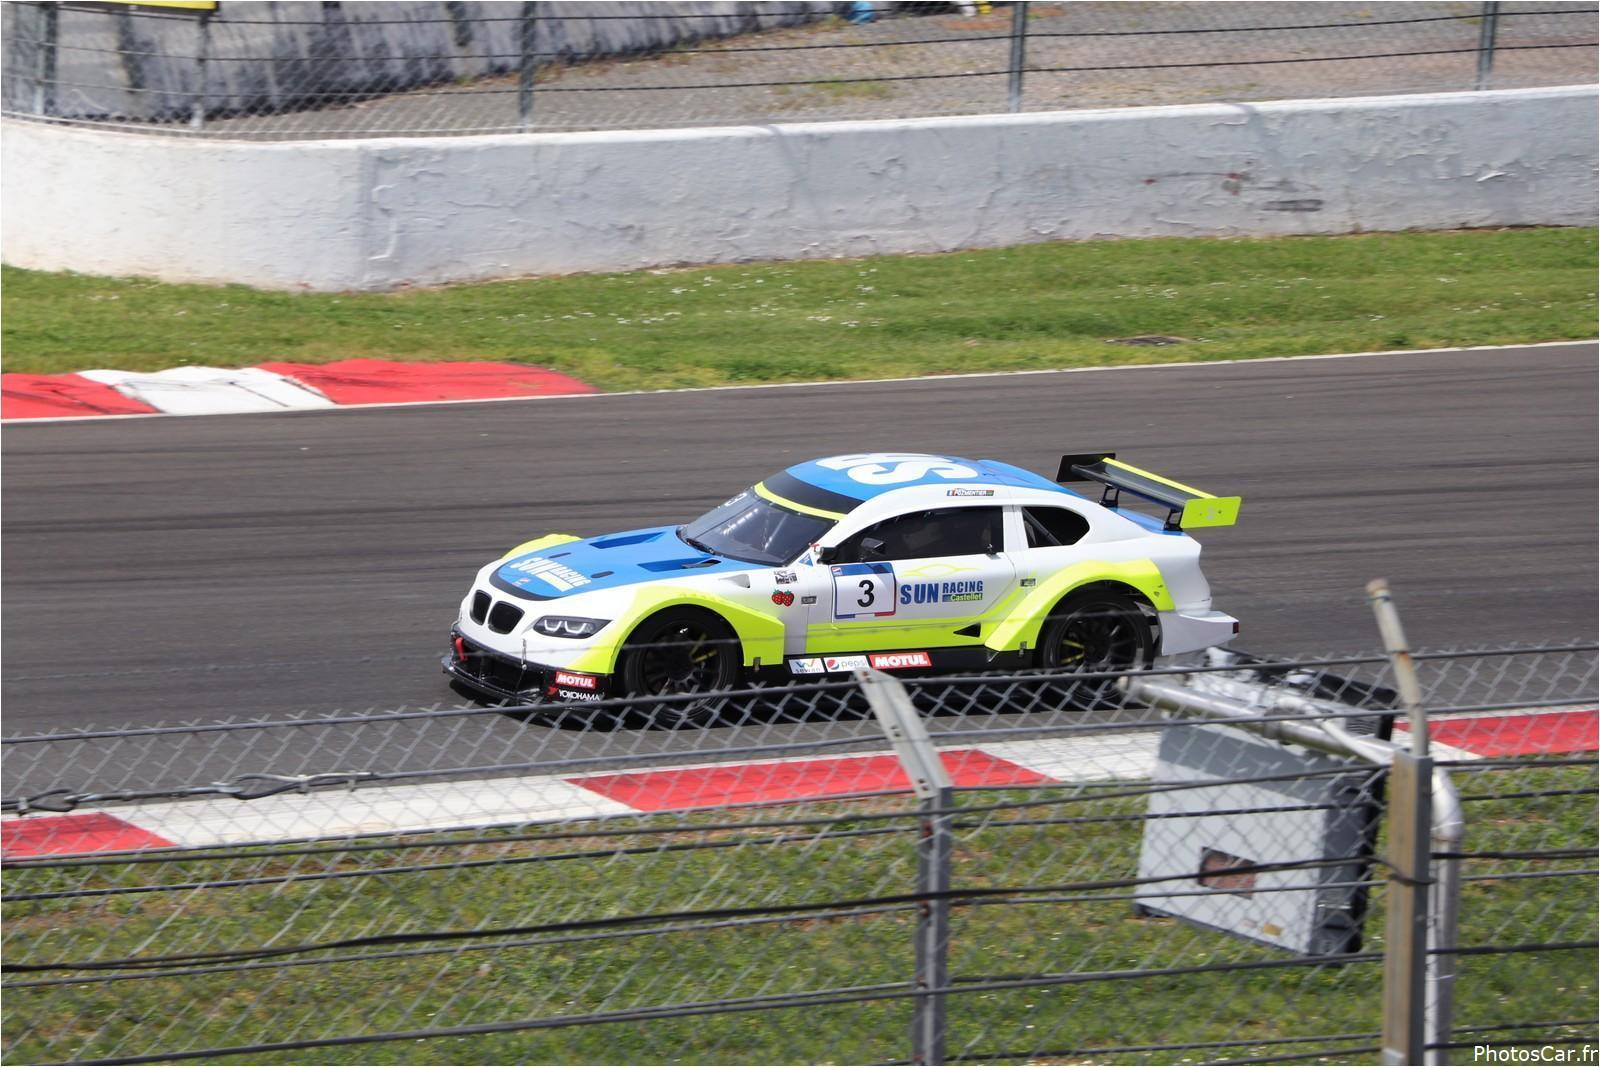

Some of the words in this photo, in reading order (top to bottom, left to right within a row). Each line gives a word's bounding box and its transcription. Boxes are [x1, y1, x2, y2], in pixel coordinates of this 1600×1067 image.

[510, 557, 564, 576] SUN
[547, 565, 592, 587] RACING
[857, 579, 875, 608] 3
[900, 582, 939, 604] SUN
[942, 580, 984, 594] RACING
[950, 593, 983, 602] Castellet
[875, 655, 927, 667] MOTUL
[556, 674, 593, 688] MOTUL
[559, 689, 600, 701] YOKOHAMA
